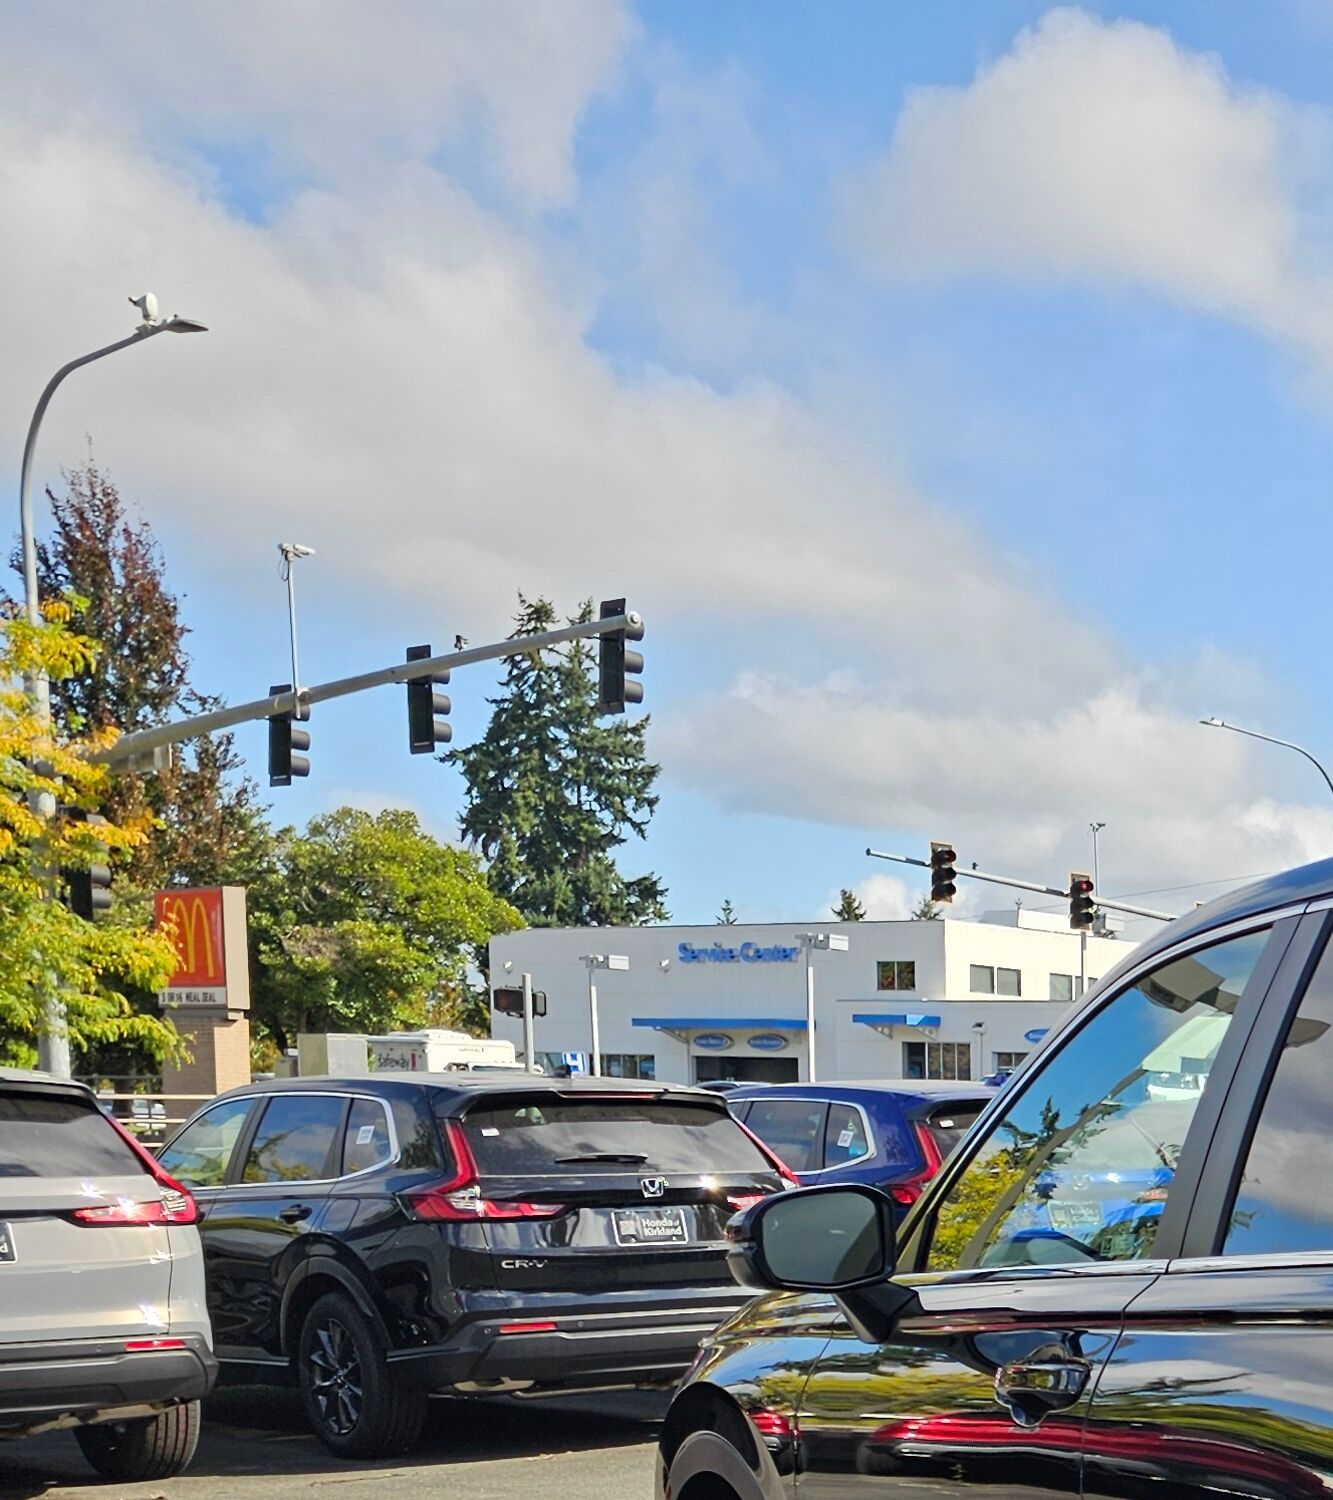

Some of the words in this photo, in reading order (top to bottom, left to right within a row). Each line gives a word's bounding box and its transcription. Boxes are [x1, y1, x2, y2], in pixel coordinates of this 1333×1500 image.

[678, 942, 739, 963] Service
[740, 941, 801, 963] Center
[642, 1217, 673, 1228] Honda
[643, 1226, 682, 1236] Kirkland
[501, 1259, 547, 1269] CR-V
